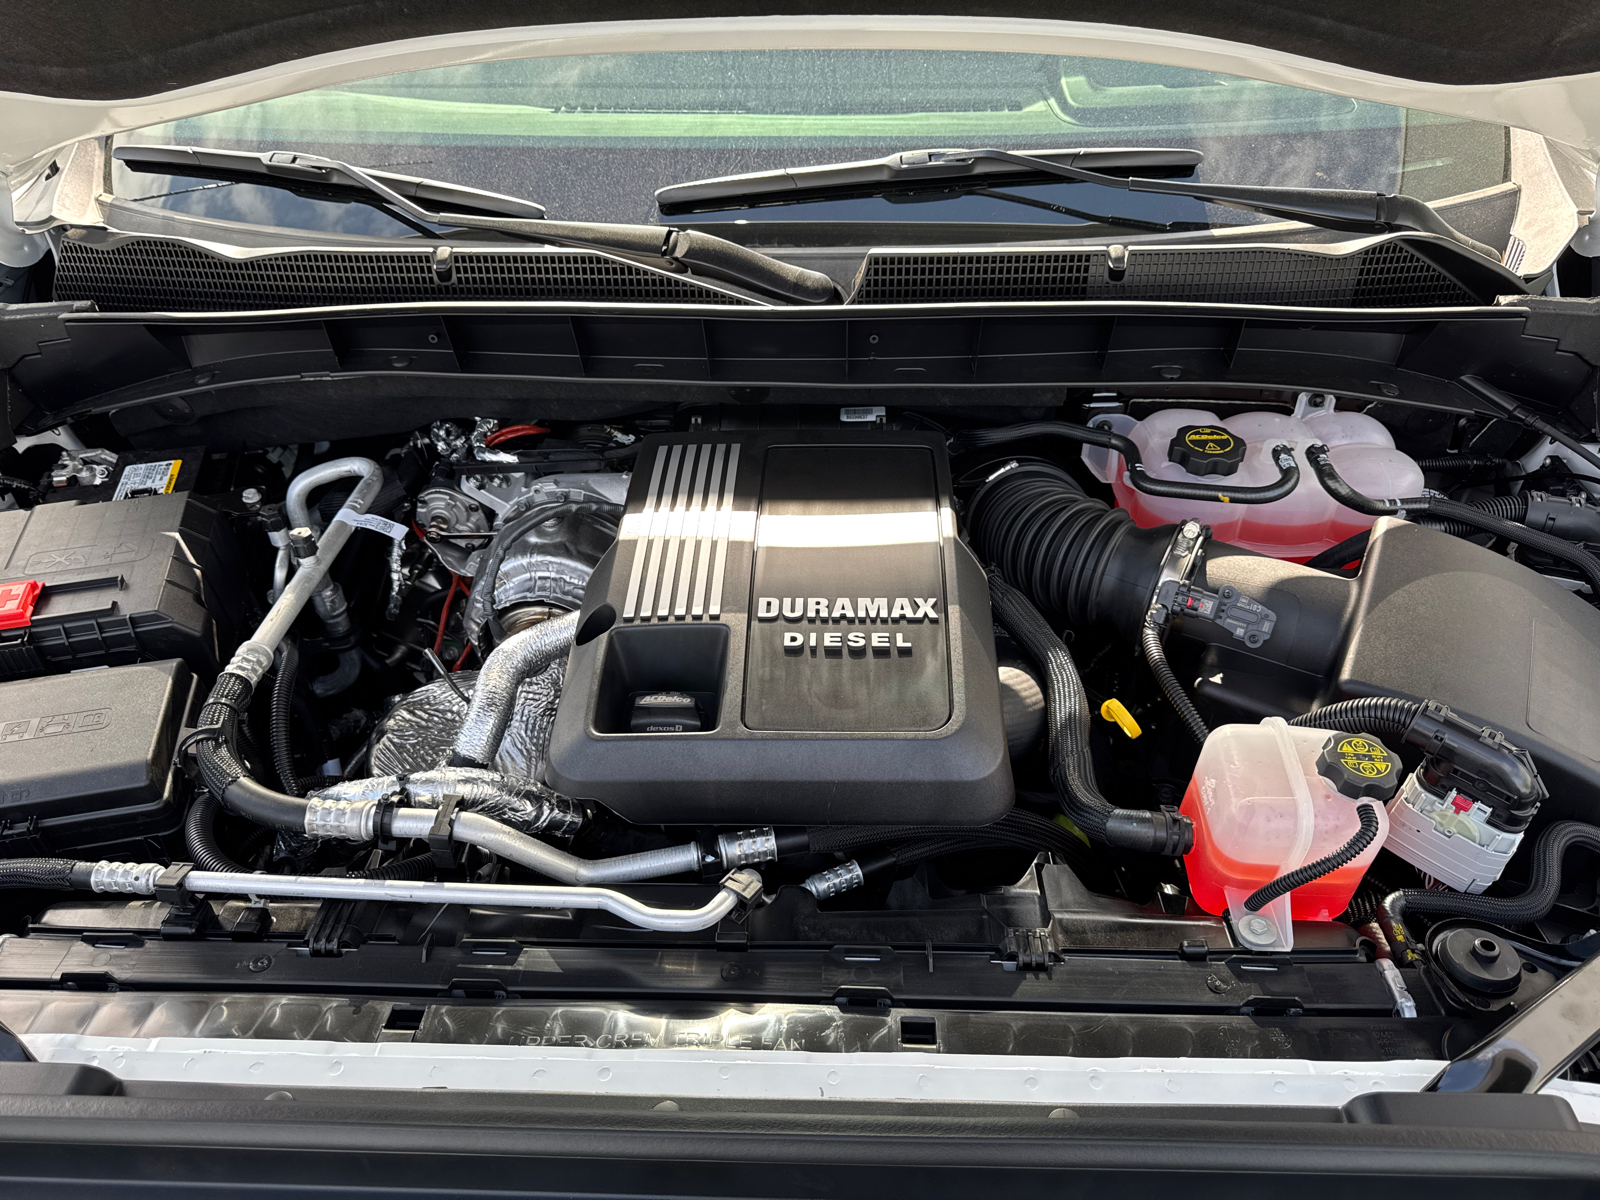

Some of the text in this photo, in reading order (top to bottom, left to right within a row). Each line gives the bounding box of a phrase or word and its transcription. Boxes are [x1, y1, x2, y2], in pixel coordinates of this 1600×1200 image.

[757, 597, 939, 621] DURAMAX
[783, 632, 912, 649] DIESEL
[639, 695, 691, 704] ACDelco
[671, 1031, 753, 1049] TRIPLE
